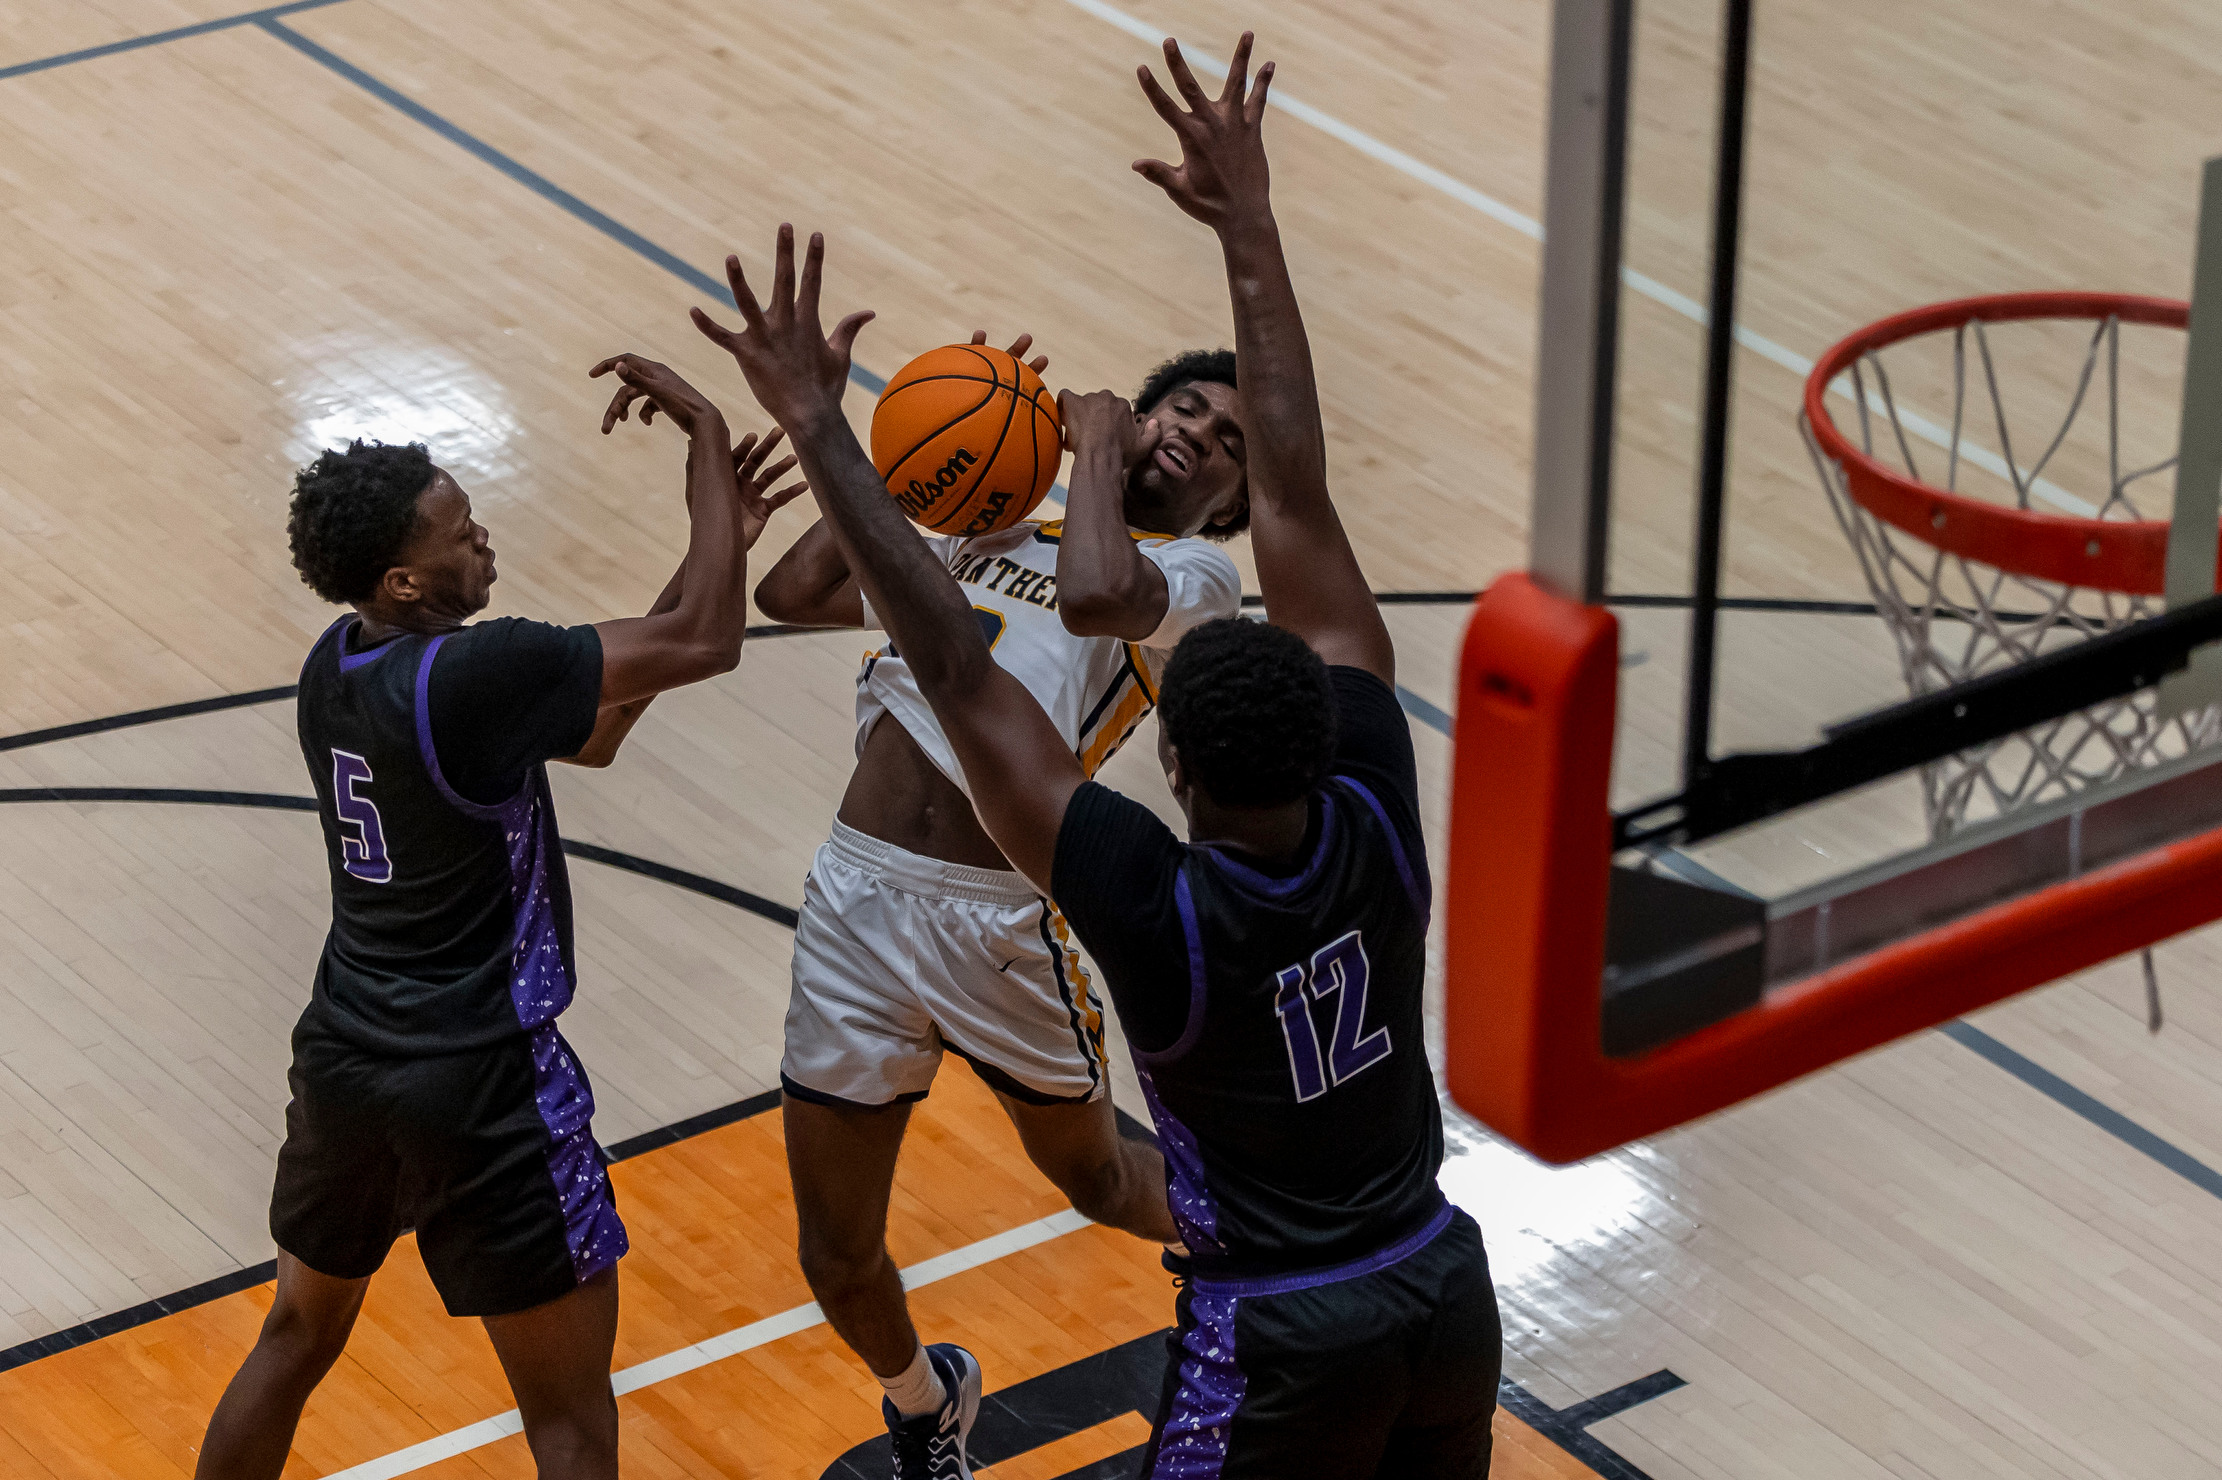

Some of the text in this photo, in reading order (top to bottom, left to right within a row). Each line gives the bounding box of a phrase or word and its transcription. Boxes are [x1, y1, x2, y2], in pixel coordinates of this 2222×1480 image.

[959, 490, 1014, 537] CAA
[331, 748, 393, 884] 5
[1274, 930, 1393, 1104] 12
